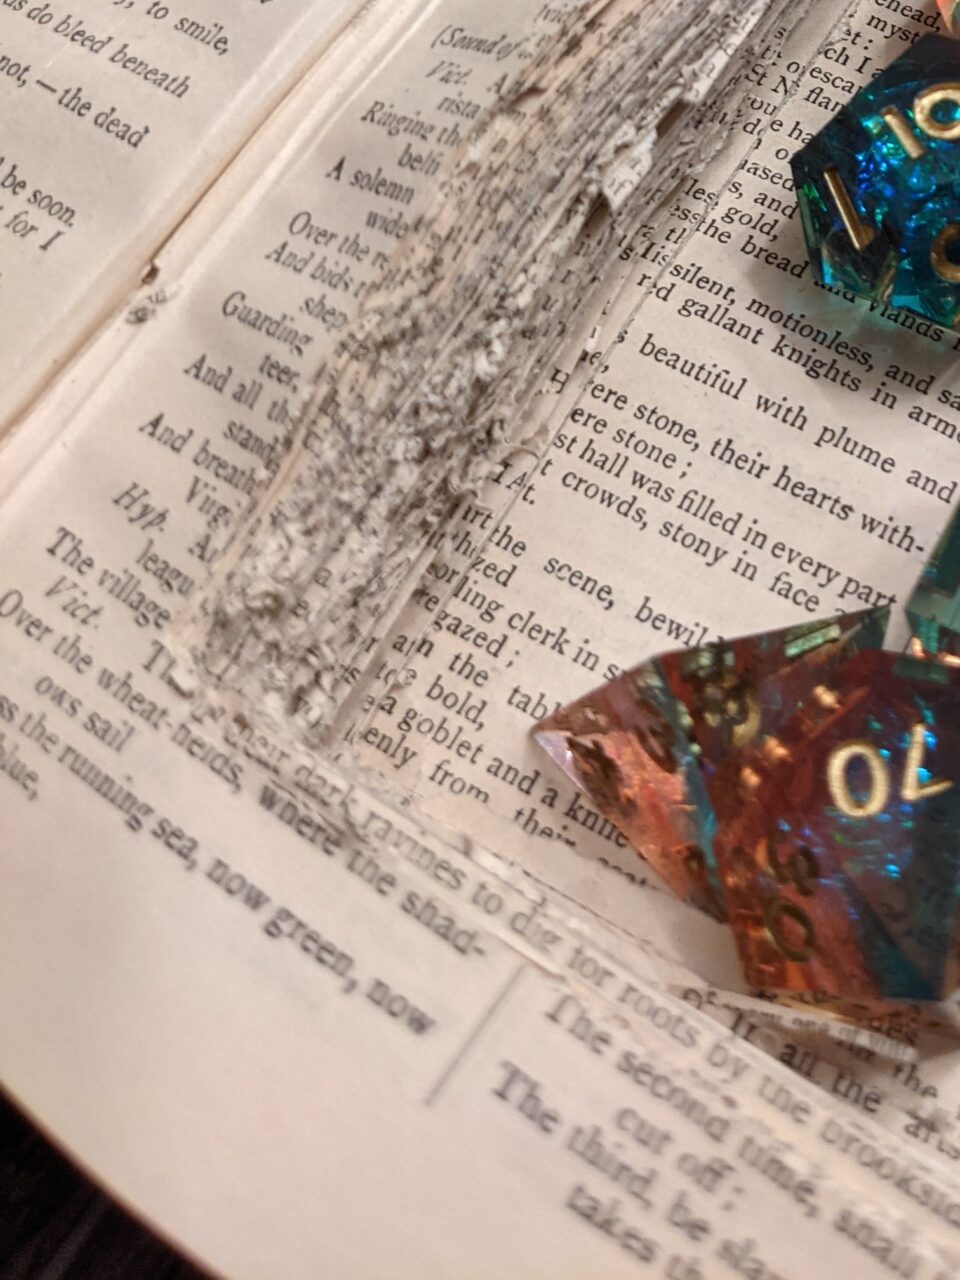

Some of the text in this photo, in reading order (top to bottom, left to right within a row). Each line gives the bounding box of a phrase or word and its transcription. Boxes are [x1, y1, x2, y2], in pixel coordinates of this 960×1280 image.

[53, 15, 191, 99] bleed beneath
[173, 16, 232, 56] smile,
[94, 107, 151, 148] dead
[362, 100, 437, 142] Ringing
[28, 190, 77, 227] soon.
[288, 212, 339, 246] Over
[726, 202, 781, 241] gold,
[740, 233, 810, 280] bread
[221, 292, 313, 358] Guarding
[669, 262, 738, 308] silent,
[744, 294, 876, 372] motionless,
[883, 360, 936, 397] and
[677, 294, 765, 346] gallant
[770, 333, 864, 394] knights
[870, 382, 898, 411] in
[184, 354, 229, 396] And
[637, 333, 958, 505] beautiful with plume and
[633, 401, 926, 555] stone, their hearts with-
[577, 431, 837, 589] hall was filled in every
[561, 465, 821, 614] crowds, stony in face
[100, 568, 171, 630] village
[543, 554, 617, 609] scene,
[507, 609, 571, 658] clerk
[425, 674, 487, 732] bold,
[397, 705, 483, 766] goblet
[206, 858, 270, 913] now
